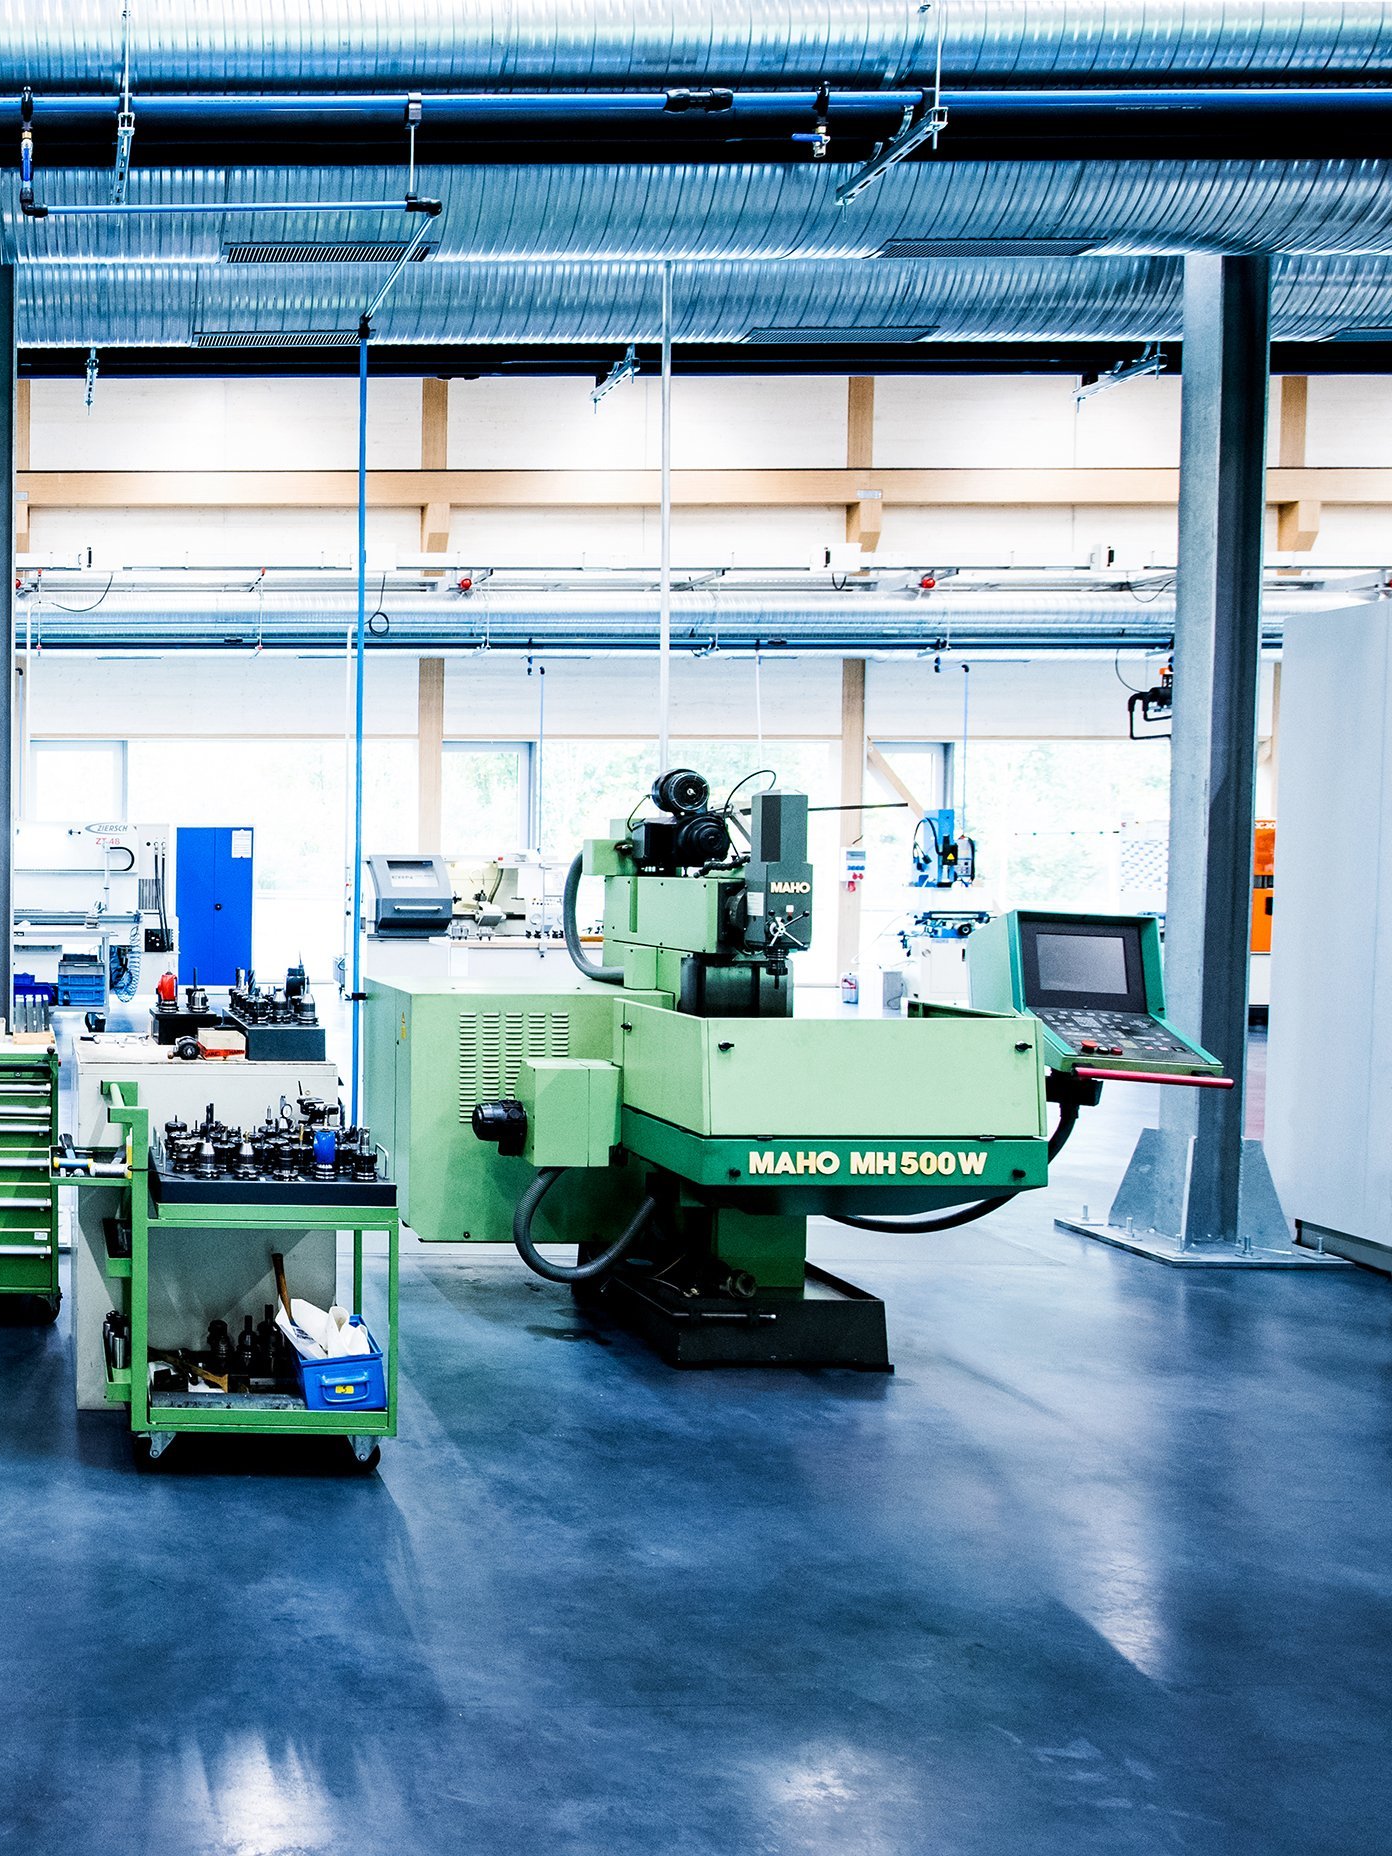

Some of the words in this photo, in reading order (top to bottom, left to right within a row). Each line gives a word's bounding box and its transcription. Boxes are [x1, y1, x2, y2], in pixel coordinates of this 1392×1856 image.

[97, 824, 129, 832] ZIERSCH
[770, 881, 811, 894] MAHO
[748, 1151, 841, 1175] MAHO
